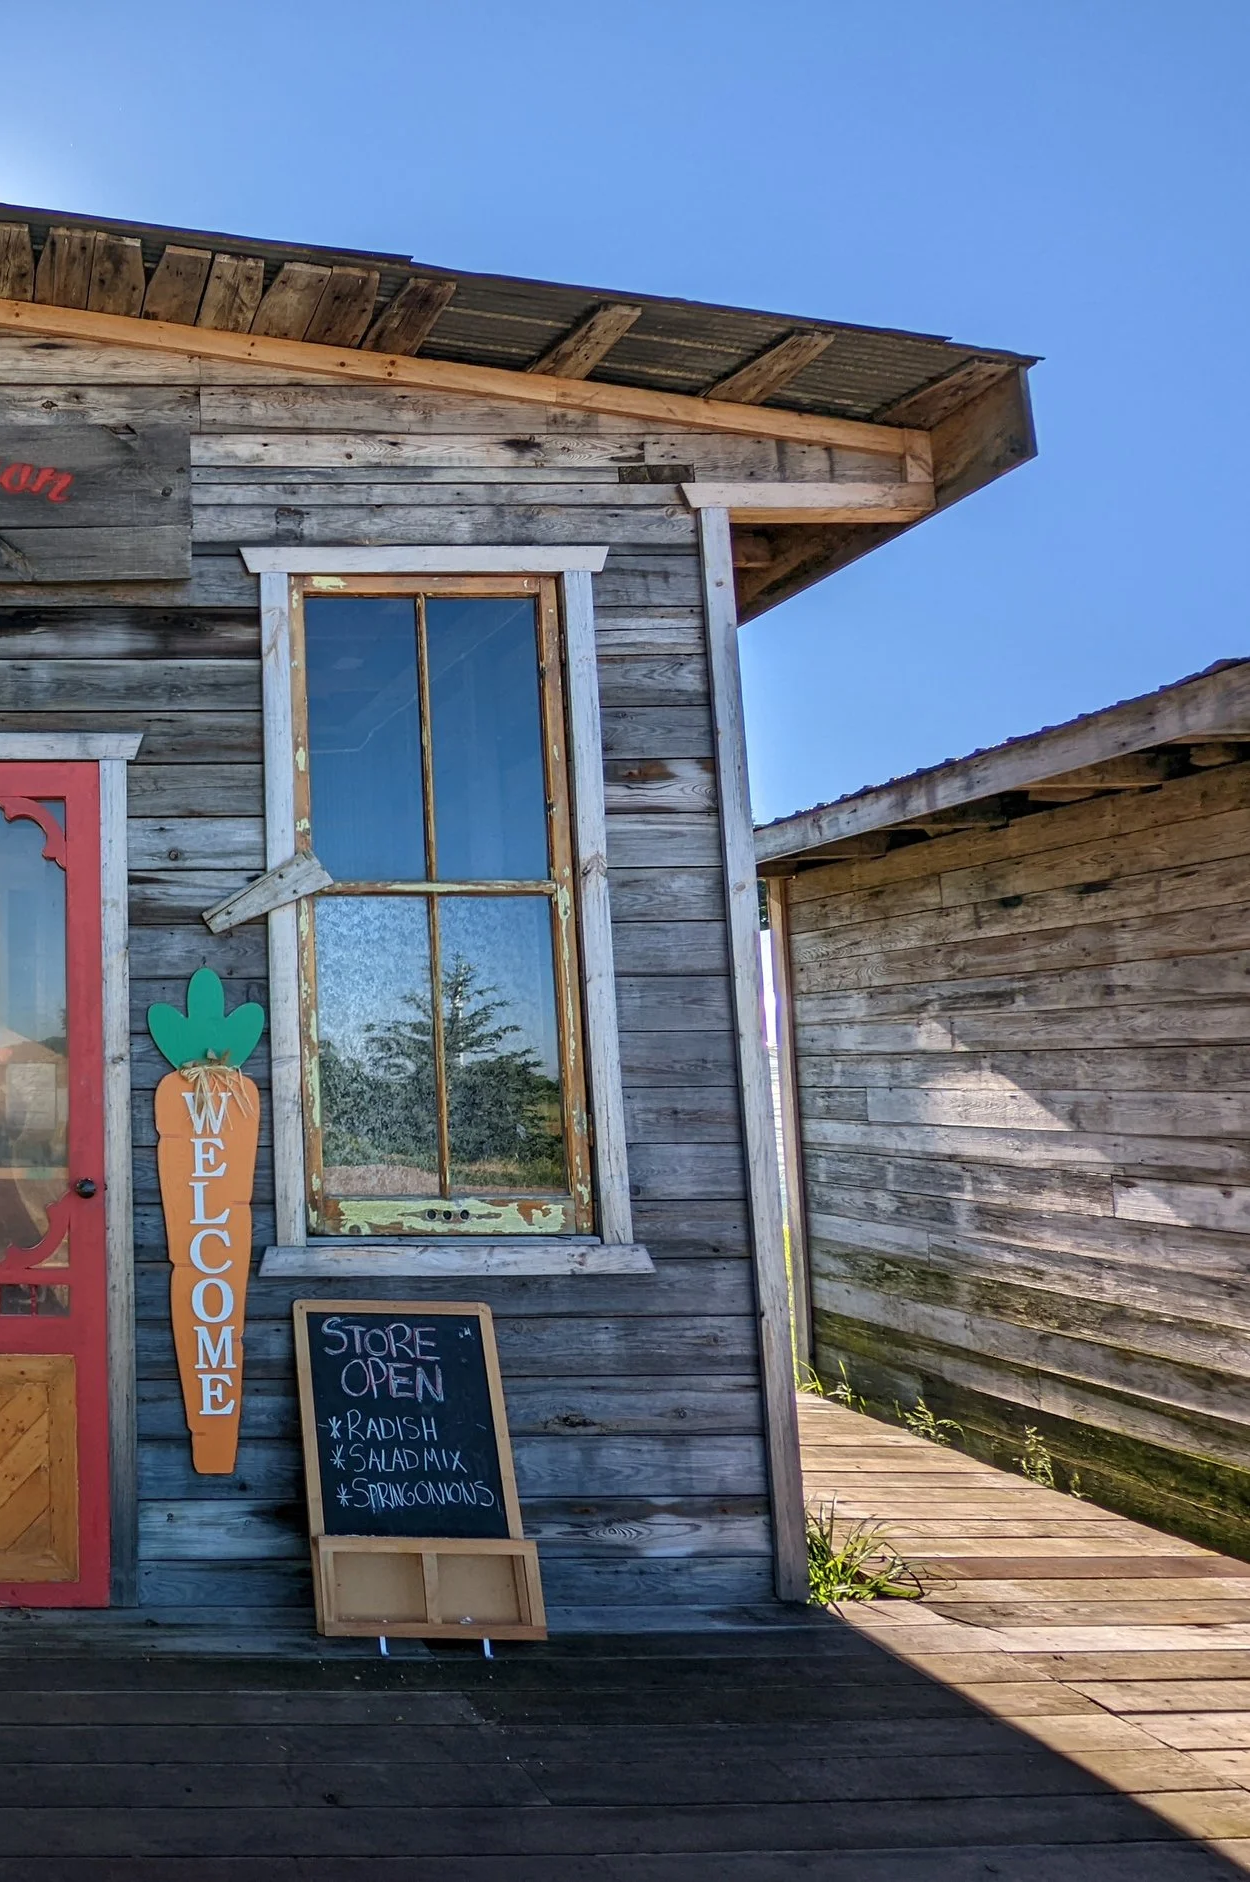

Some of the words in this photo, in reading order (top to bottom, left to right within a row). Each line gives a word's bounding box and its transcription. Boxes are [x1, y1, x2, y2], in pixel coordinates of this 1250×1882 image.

[181, 1091, 237, 1416] WELCOME
[321, 1316, 441, 1361] STORE
[341, 1358, 445, 1402] OPEN
[346, 1408, 438, 1441] RADISH
[349, 1443, 419, 1473] SALAD
[423, 1447, 468, 1474] MIX
